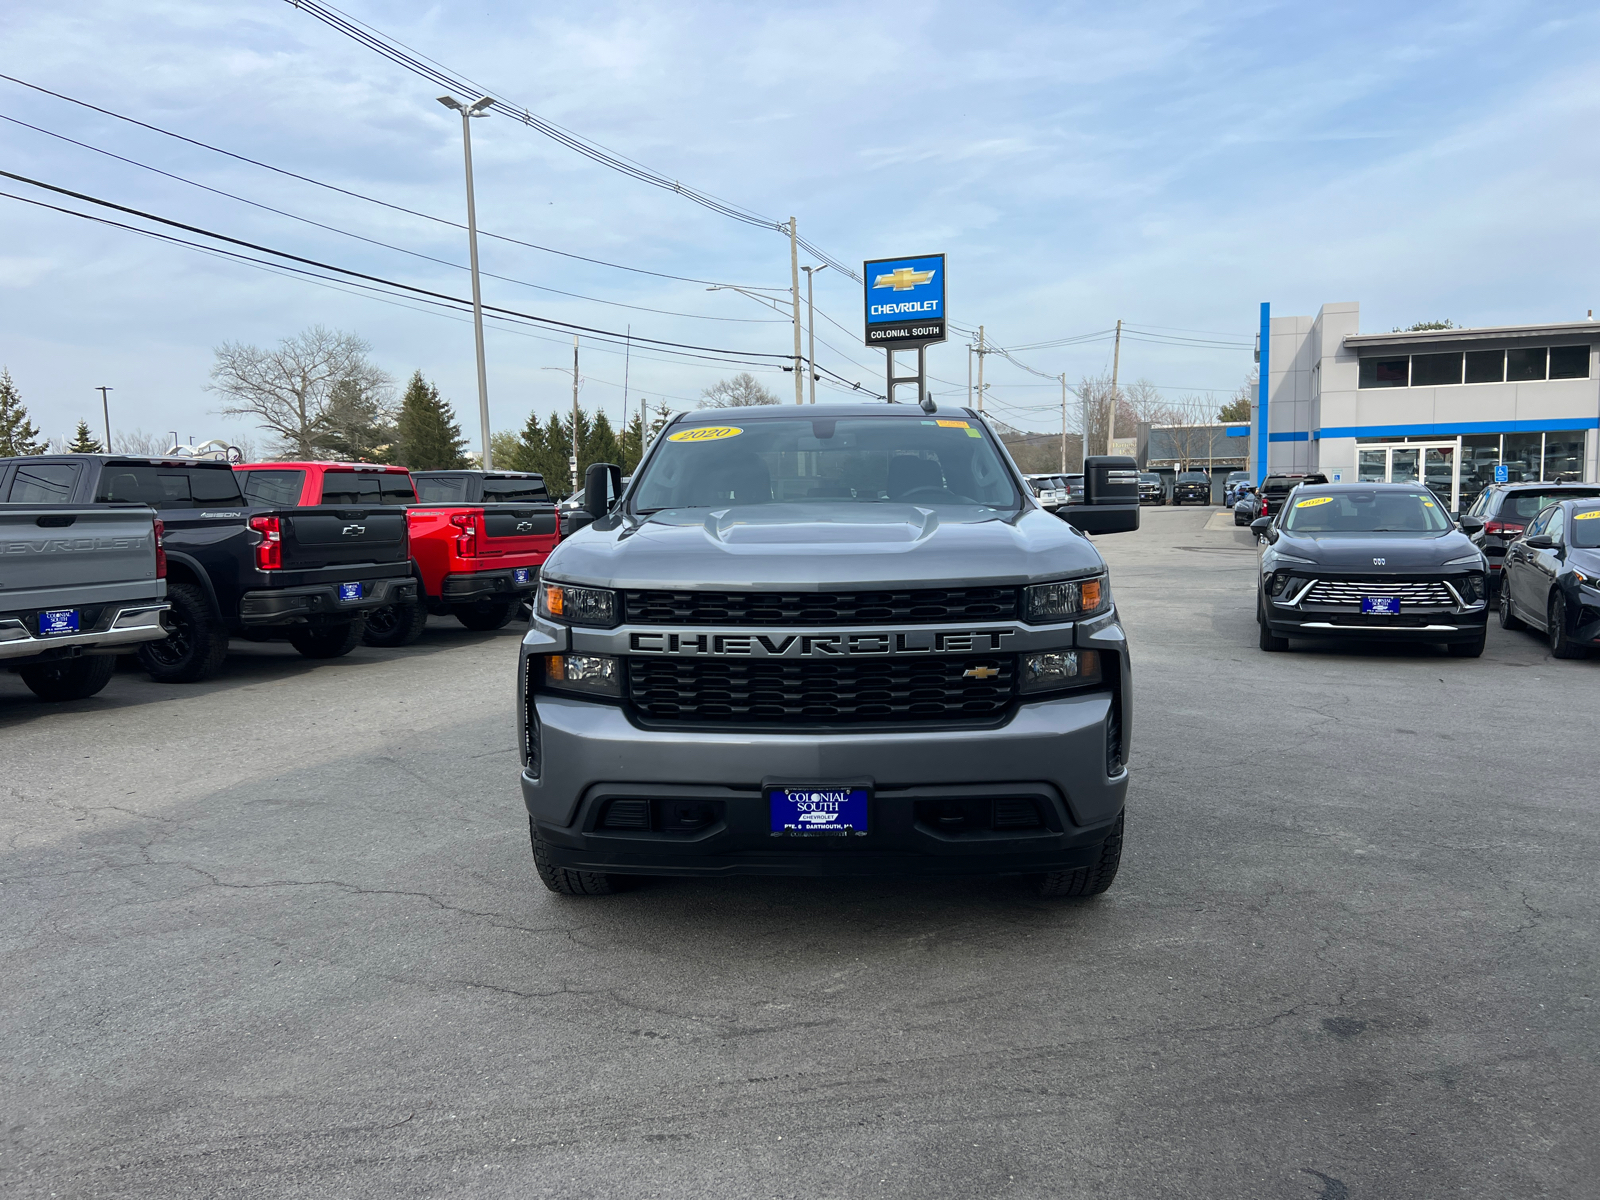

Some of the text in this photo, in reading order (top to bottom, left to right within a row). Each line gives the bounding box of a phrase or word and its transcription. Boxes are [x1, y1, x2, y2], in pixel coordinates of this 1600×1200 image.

[871, 300, 938, 315] CHEVROLET
[871, 326, 939, 339] COLONIAL SOUTH
[678, 428, 731, 440] 2020
[1302, 498, 1328, 507] 2024
[628, 629, 1015, 656] CHEVROLET
[788, 792, 848, 802] COLONIAL
[797, 802, 839, 811] SOUTH
